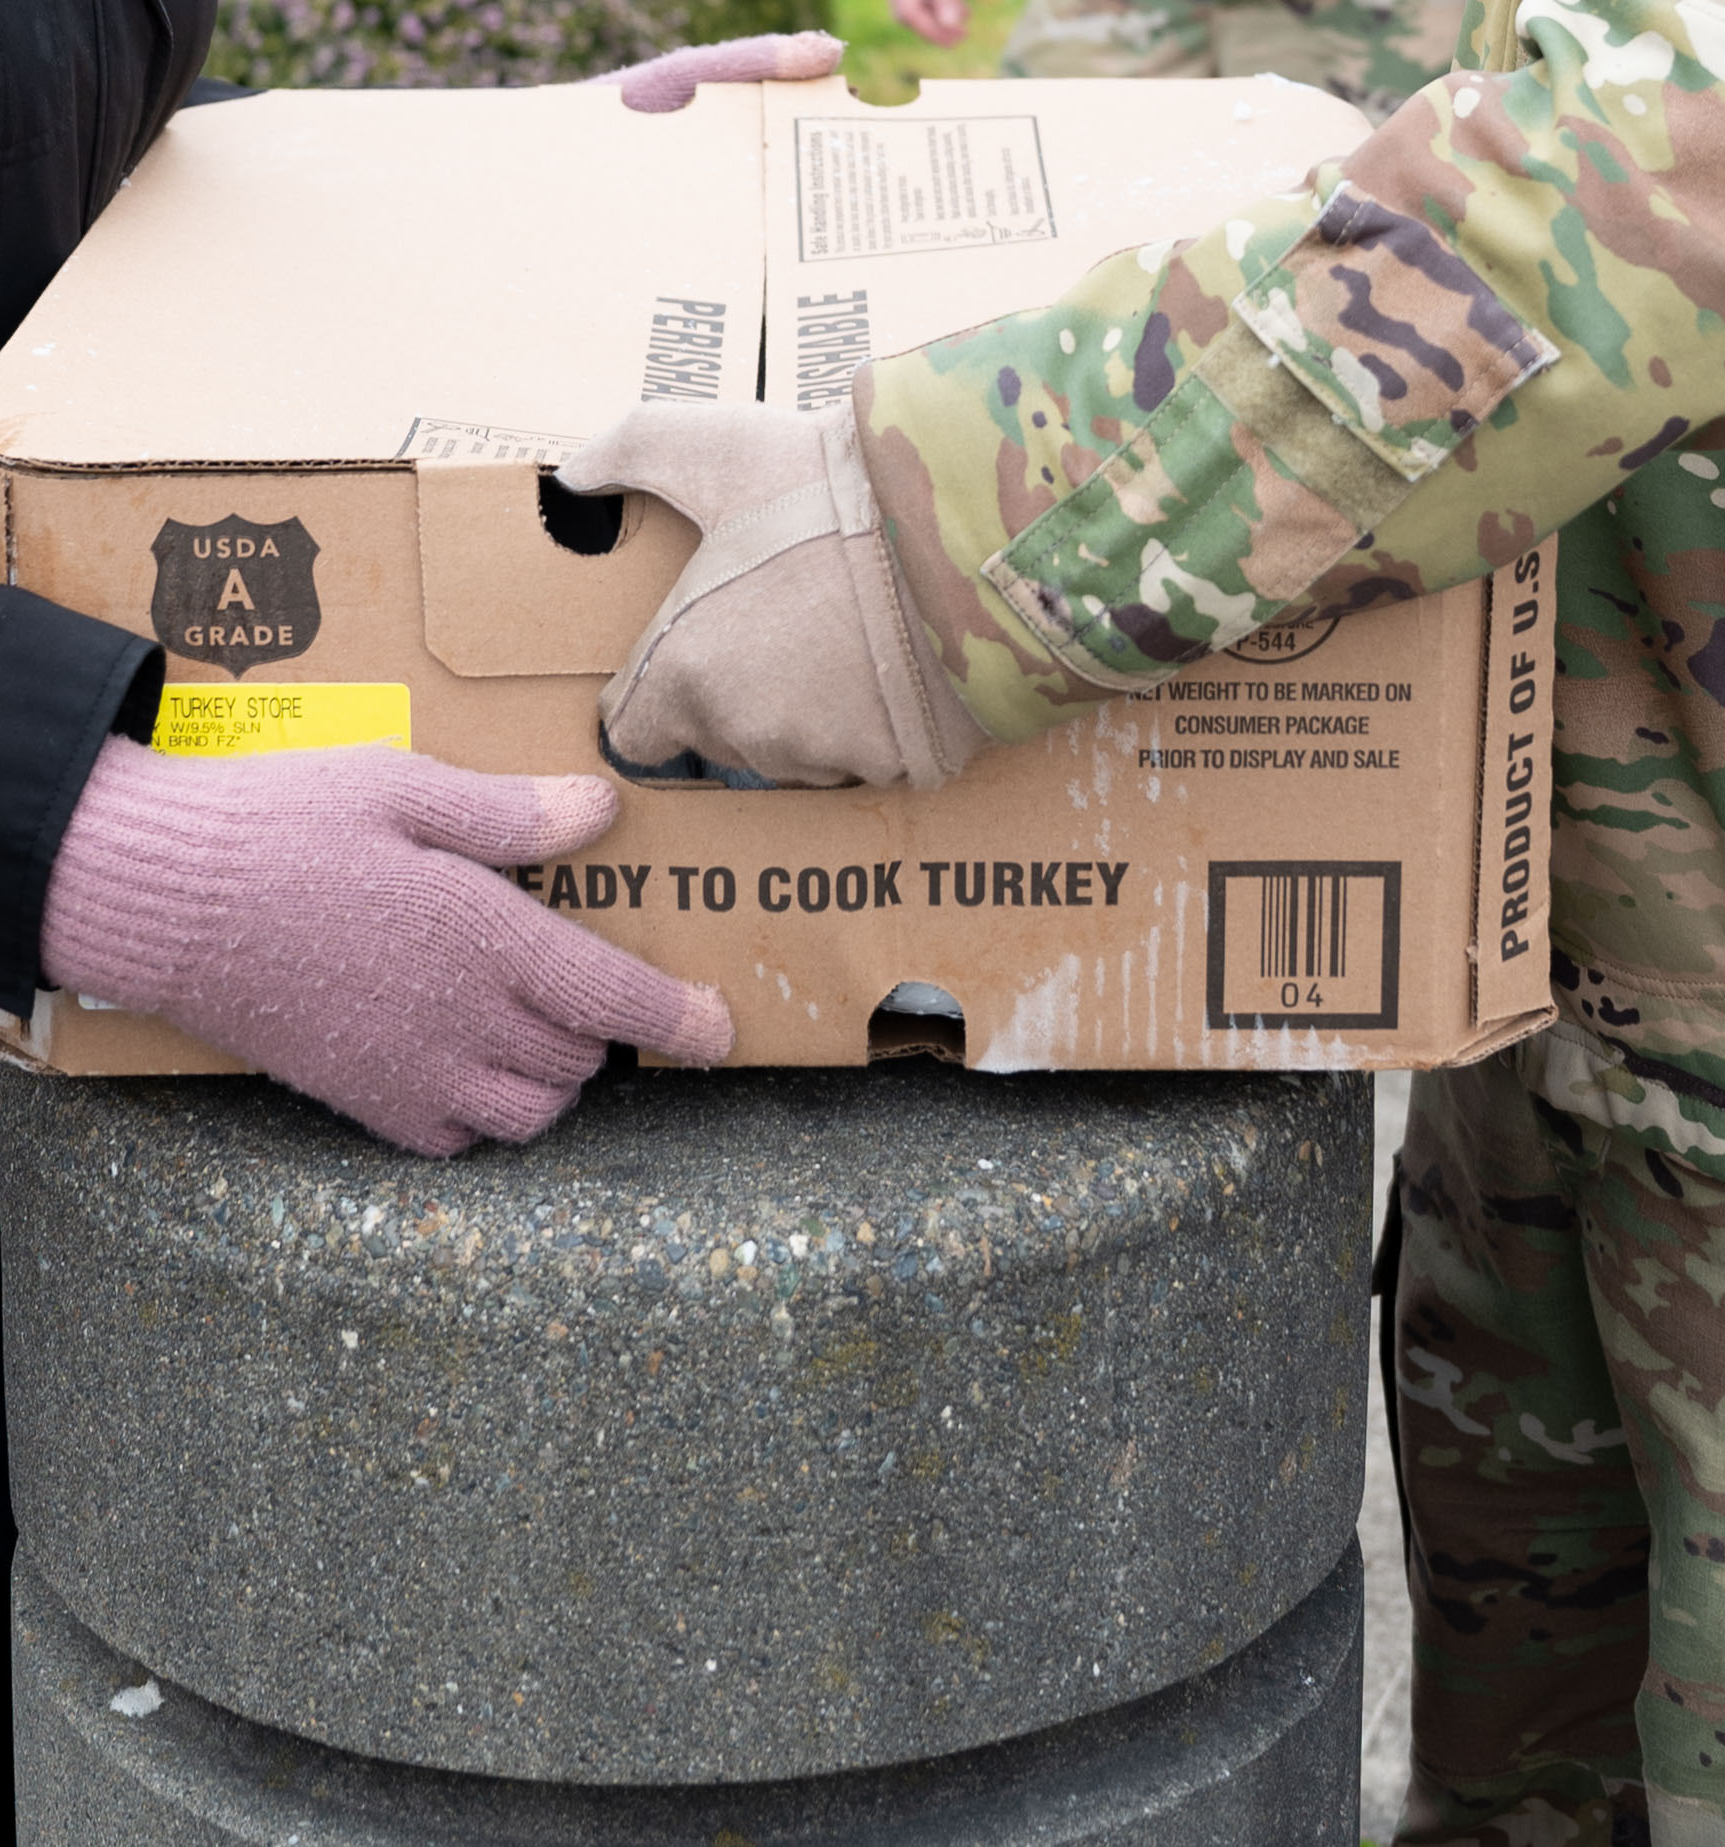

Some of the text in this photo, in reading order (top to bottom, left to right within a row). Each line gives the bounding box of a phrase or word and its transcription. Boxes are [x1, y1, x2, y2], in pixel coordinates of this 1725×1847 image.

[807, 131, 829, 255] Safe Handling Instructions
[640, 295, 728, 403] PERISHA
[192, 537, 280, 560] USDA
[216, 567, 256, 611] A
[184, 625, 294, 647] GRADE
[1235, 631, 1296, 653] P-544
[1168, 682, 1241, 701] WEIGHT
[1244, 682, 1270, 701] TO
[1273, 683, 1297, 701] BE
[1301, 683, 1381, 701] MARKED
[1384, 683, 1412, 702] ON
[1509, 650, 1536, 715] OF
[169, 697, 303, 719] TURKEY STORE
[233, 721, 261, 734] SLN
[1174, 715, 1370, 735] CONSUMER PACKAGE
[168, 735, 209, 747] BRND
[1138, 749, 1400, 769] PRIOR TO DISPLAY AND SALE
[1500, 732, 1535, 963] PRODUCT
[515, 860, 1130, 913] EADY TO COOK TURKEY
[1280, 982, 1324, 1008] 04
